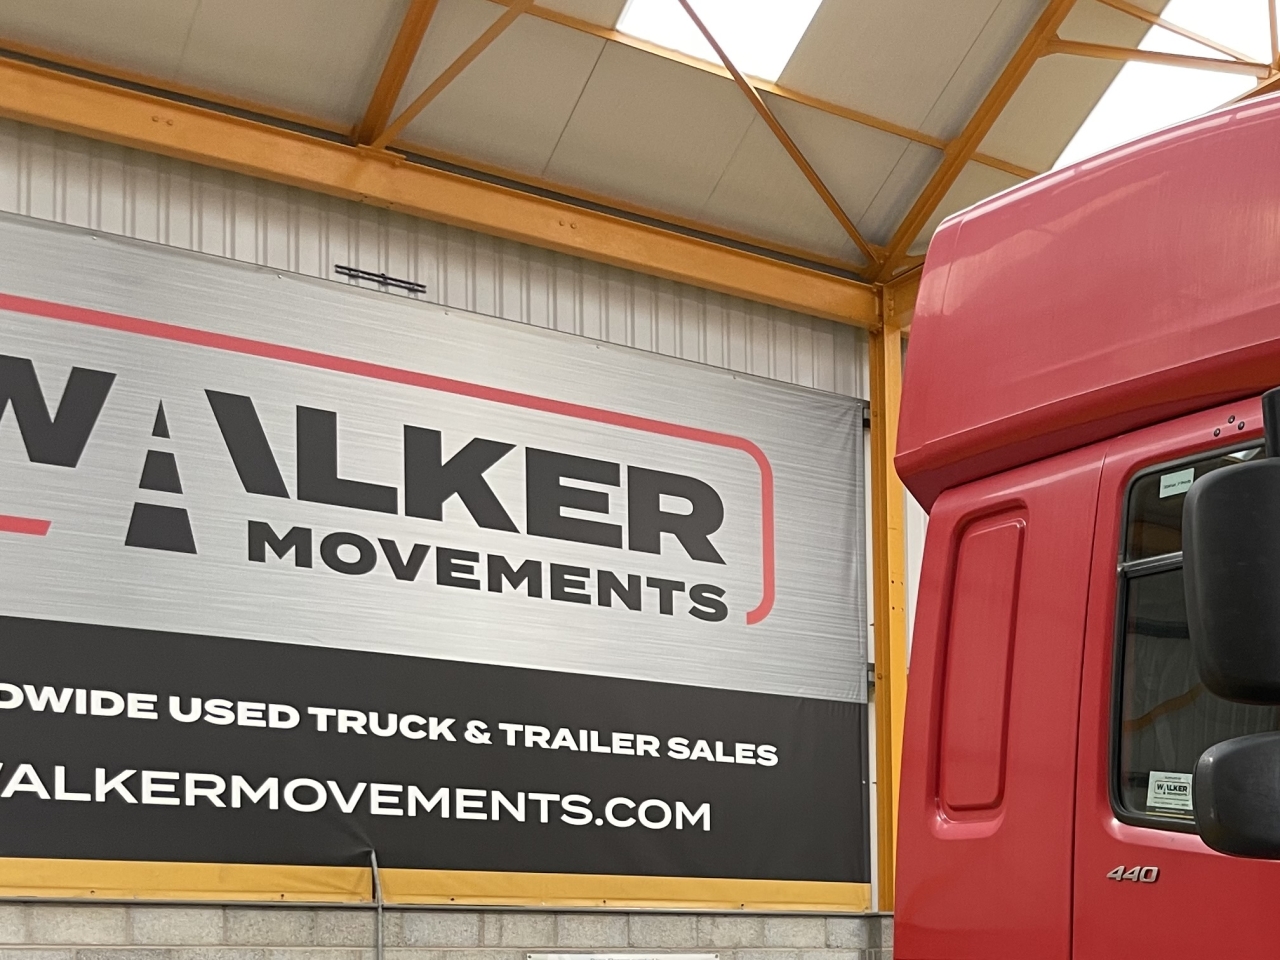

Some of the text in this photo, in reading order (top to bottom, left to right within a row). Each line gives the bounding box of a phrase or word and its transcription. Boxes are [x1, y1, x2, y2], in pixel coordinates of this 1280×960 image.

[247, 519, 729, 622] MOVEMENTS
[168, 695, 300, 730] USED
[307, 706, 457, 743] TRUCK
[463, 719, 493, 746] &
[498, 722, 661, 758] TRAILER
[667, 736, 779, 767] SALES
[0, 762, 712, 832] ALKERMOVEMENTS.COM
[1106, 865, 1159, 883] 440
